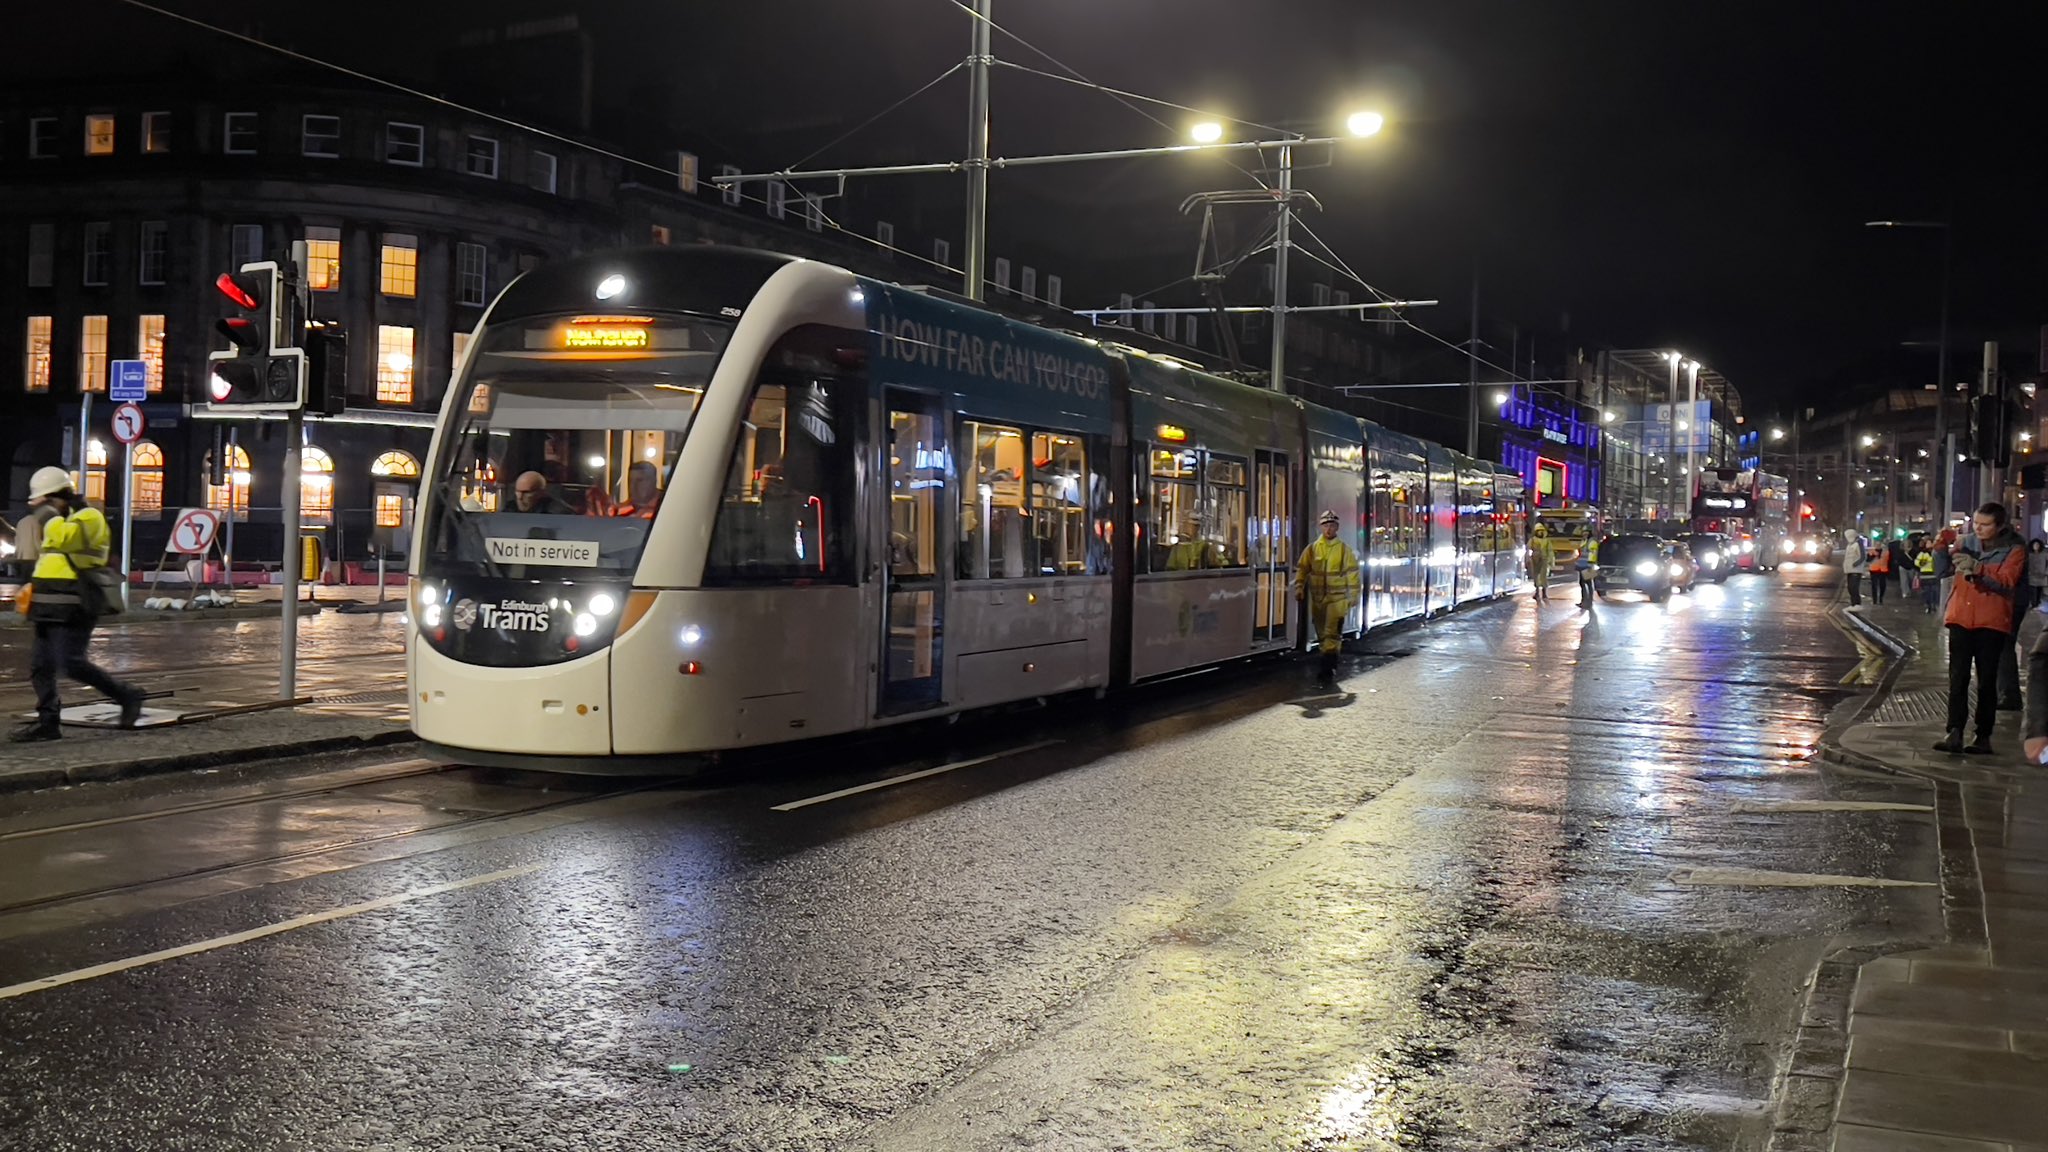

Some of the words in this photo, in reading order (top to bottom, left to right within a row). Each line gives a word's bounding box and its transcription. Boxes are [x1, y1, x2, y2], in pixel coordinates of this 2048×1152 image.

[879, 313, 942, 366] HOW
[946, 330, 985, 376] FAR
[989, 340, 1030, 385] CAN
[1034, 351, 1070, 393] YOU
[1072, 361, 1107, 400] GO?
[493, 541, 519, 558] Not
[524, 543, 535, 558] in
[540, 544, 590, 560] service
[480, 604, 549, 631] Trams
[501, 599, 549, 613] Edinburgh
